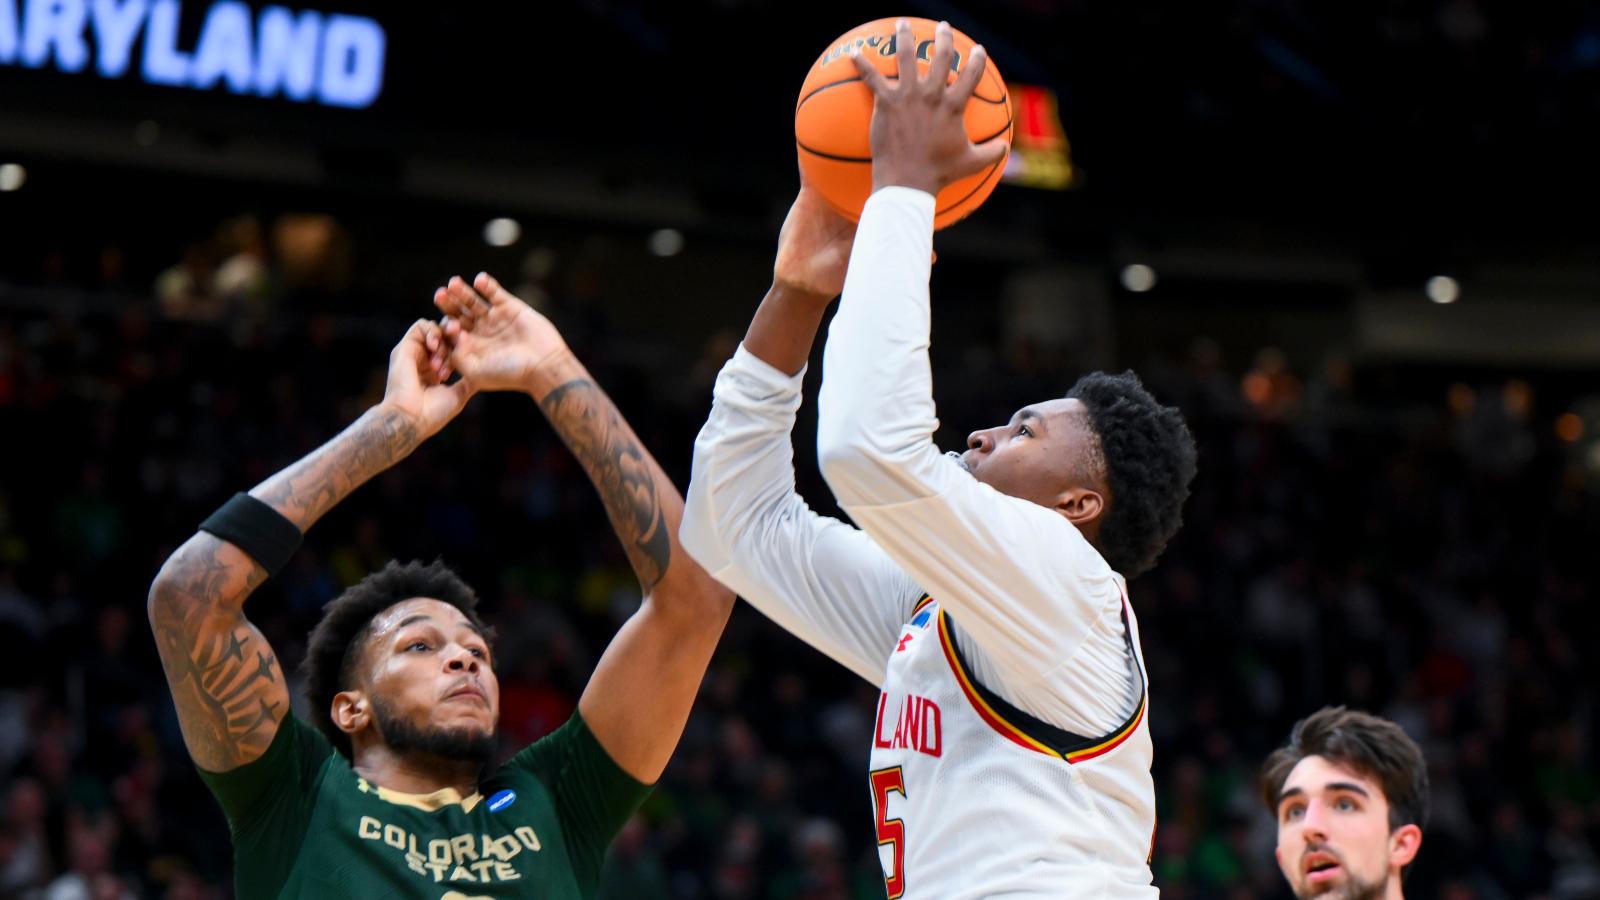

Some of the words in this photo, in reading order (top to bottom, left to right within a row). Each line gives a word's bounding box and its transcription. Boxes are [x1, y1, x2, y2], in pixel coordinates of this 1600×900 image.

[358, 815, 541, 865] COLORADO
[870, 765, 907, 900] 5
[406, 855, 522, 883] STATE
